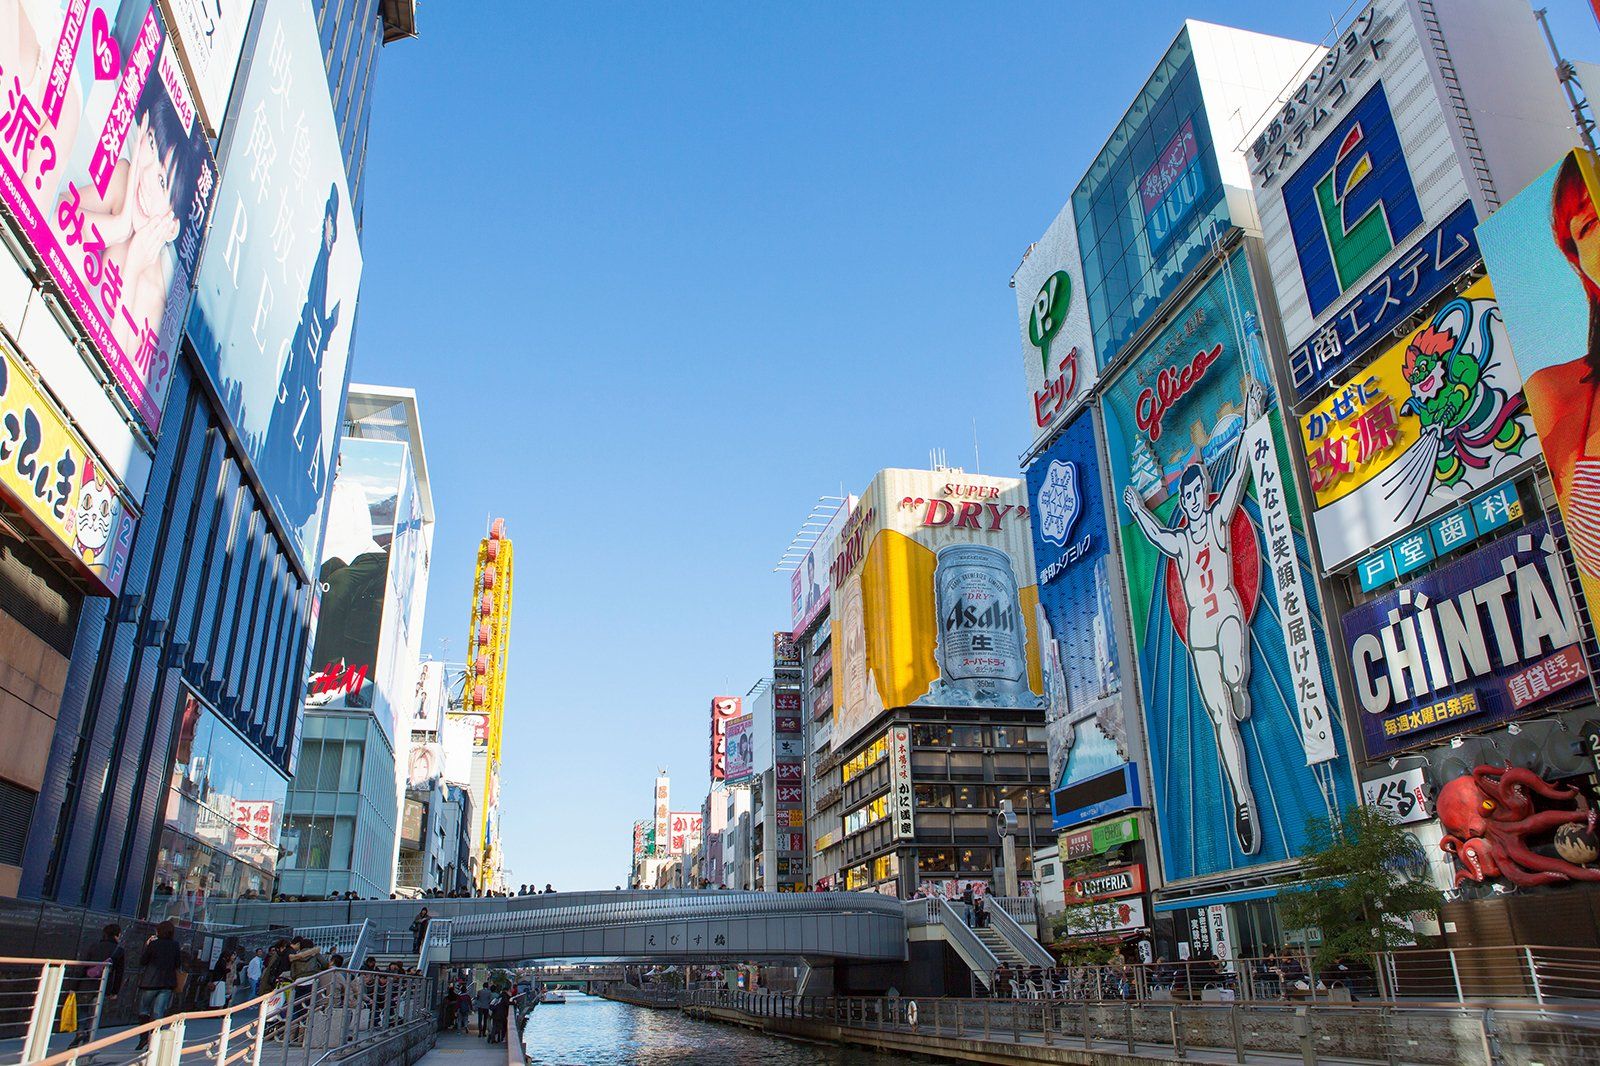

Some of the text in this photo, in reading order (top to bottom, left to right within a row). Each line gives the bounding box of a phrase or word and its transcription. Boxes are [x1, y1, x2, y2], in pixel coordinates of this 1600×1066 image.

[95, 29, 113, 73] VS
[162, 56, 193, 131] NMB48
[1252, 7, 1374, 162] 夢あるマンション
[1260, 39, 1387, 188] エステムコート
[160, 160, 214, 342] 渡辺美優紀
[1289, 227, 1470, 390] 日商エステム
[223, 189, 325, 495] REGZA
[1033, 346, 1078, 429] ピップ
[1136, 342, 1224, 443] Glico
[1306, 375, 1381, 441] かぜに
[1307, 396, 1399, 492] 改源
[944, 483, 1000, 500] SUPER
[1510, 505, 1520, 518] 3F
[841, 505, 863, 543] SUPER
[1366, 489, 1512, 585] 戸堂歯科
[109, 515, 131, 583] 2F
[1040, 534, 1092, 585] 雪印メグミルク
[1195, 541, 1220, 619] グリコ
[1254, 437, 1327, 740] みんなに笑顔を届けたい。
[946, 597, 1015, 633] Asahi
[963, 657, 1006, 667] スーパードライ
[971, 634, 994, 651] 生
[1544, 653, 1568, 674] 住宅
[311, 661, 369, 695] H&M
[1508, 665, 1551, 706] 賃貸
[1549, 661, 1587, 688] ニュース
[1384, 692, 1477, 737] 毎週水曜日発売
[899, 782, 912, 833] かに道楽
[1377, 779, 1416, 817] くくる
[673, 817, 703, 833] かに
[1084, 874, 1128, 895] LOTTERIA
[649, 934, 726, 946] えびす橋
